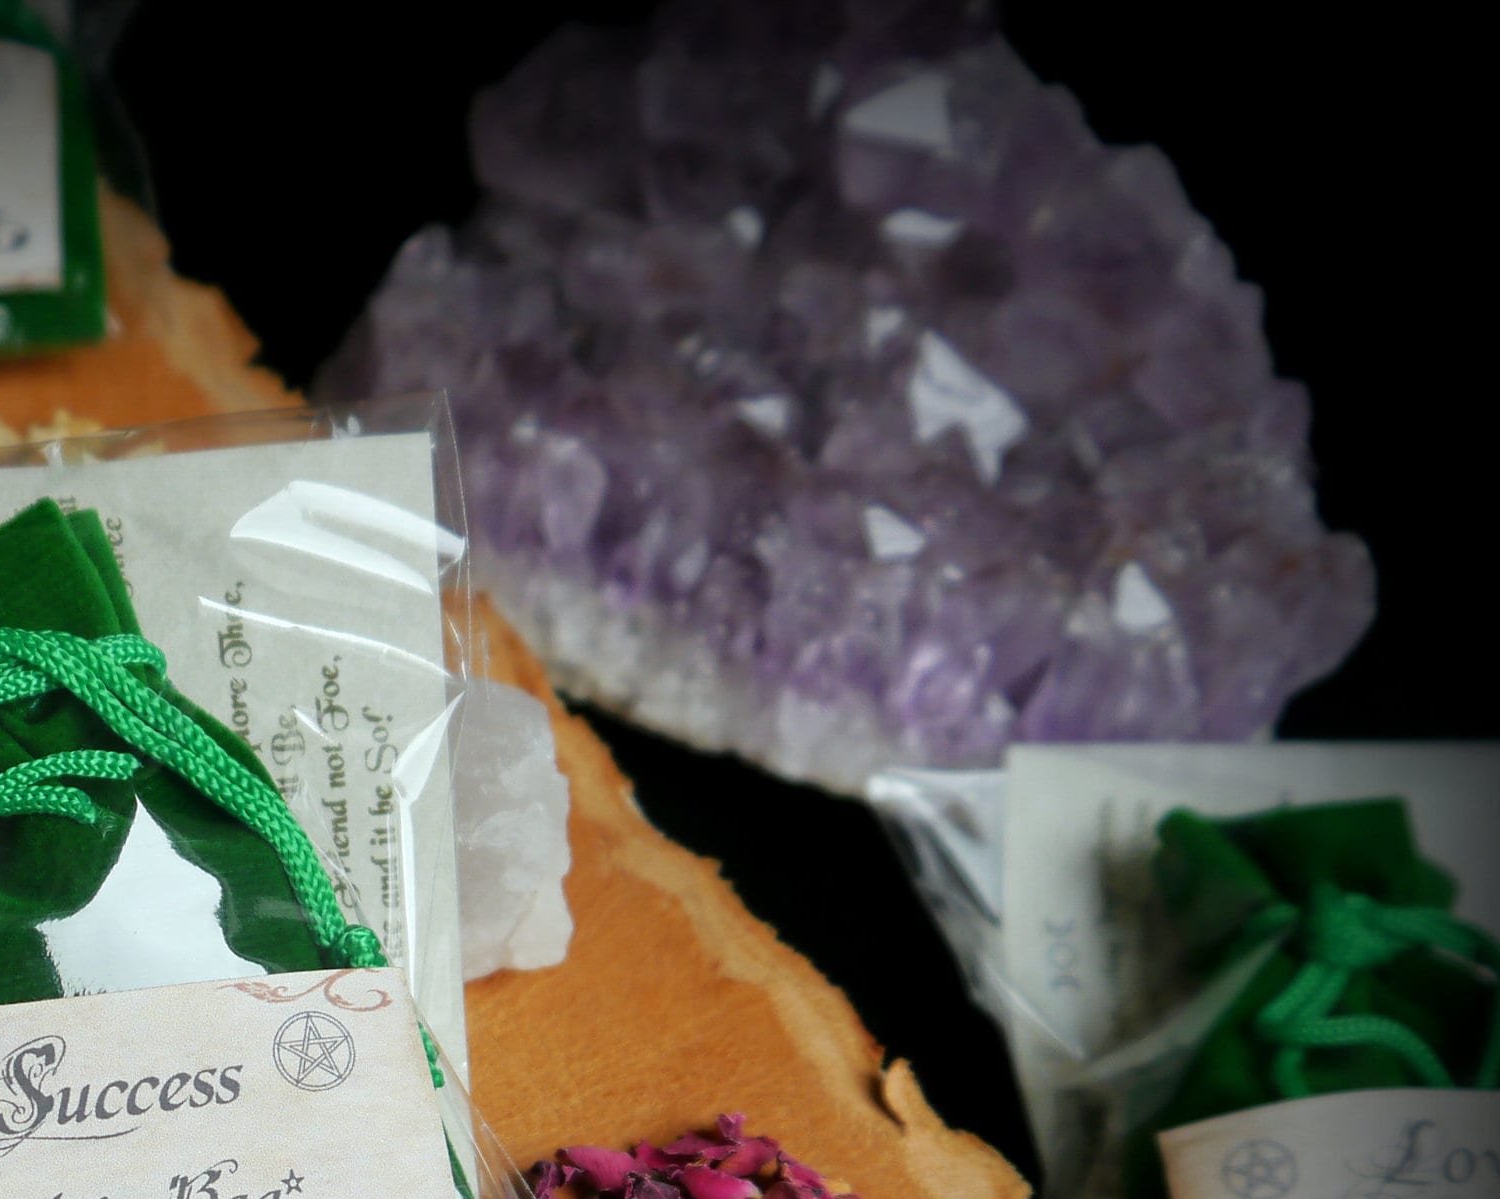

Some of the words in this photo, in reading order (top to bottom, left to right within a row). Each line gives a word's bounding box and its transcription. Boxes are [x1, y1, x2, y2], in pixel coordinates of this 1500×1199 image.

[314, 654, 350, 735] Foe,
[323, 742, 347, 789] not
[367, 783, 395, 816] be
